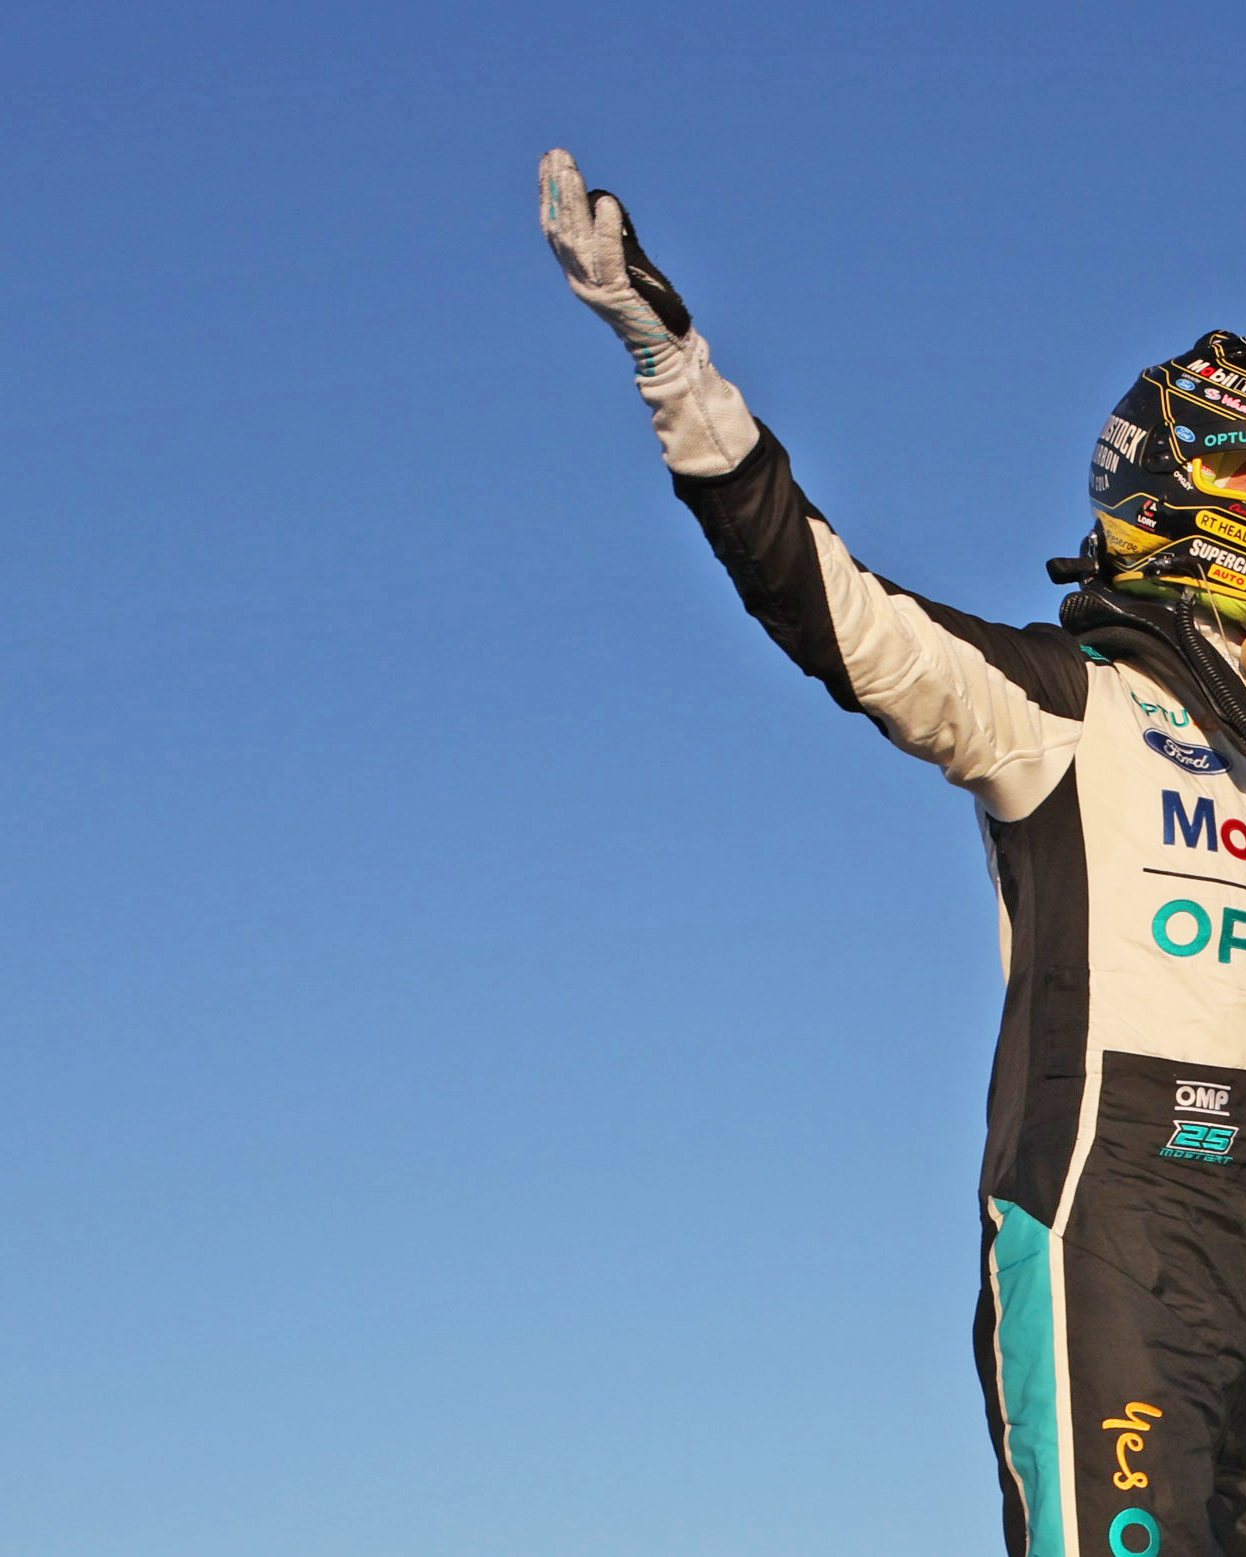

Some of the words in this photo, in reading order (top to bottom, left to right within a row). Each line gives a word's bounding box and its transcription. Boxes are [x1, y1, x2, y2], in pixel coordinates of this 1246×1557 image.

[1187, 359, 1239, 388] Mobil
[1201, 514, 1215, 530] RT
[1212, 569, 1245, 586] AUTO
[1131, 692, 1190, 727] PTU
[1164, 738, 1210, 769] Ford
[1175, 1085, 1230, 1110] OMP
[1173, 1124, 1235, 1151] 25
